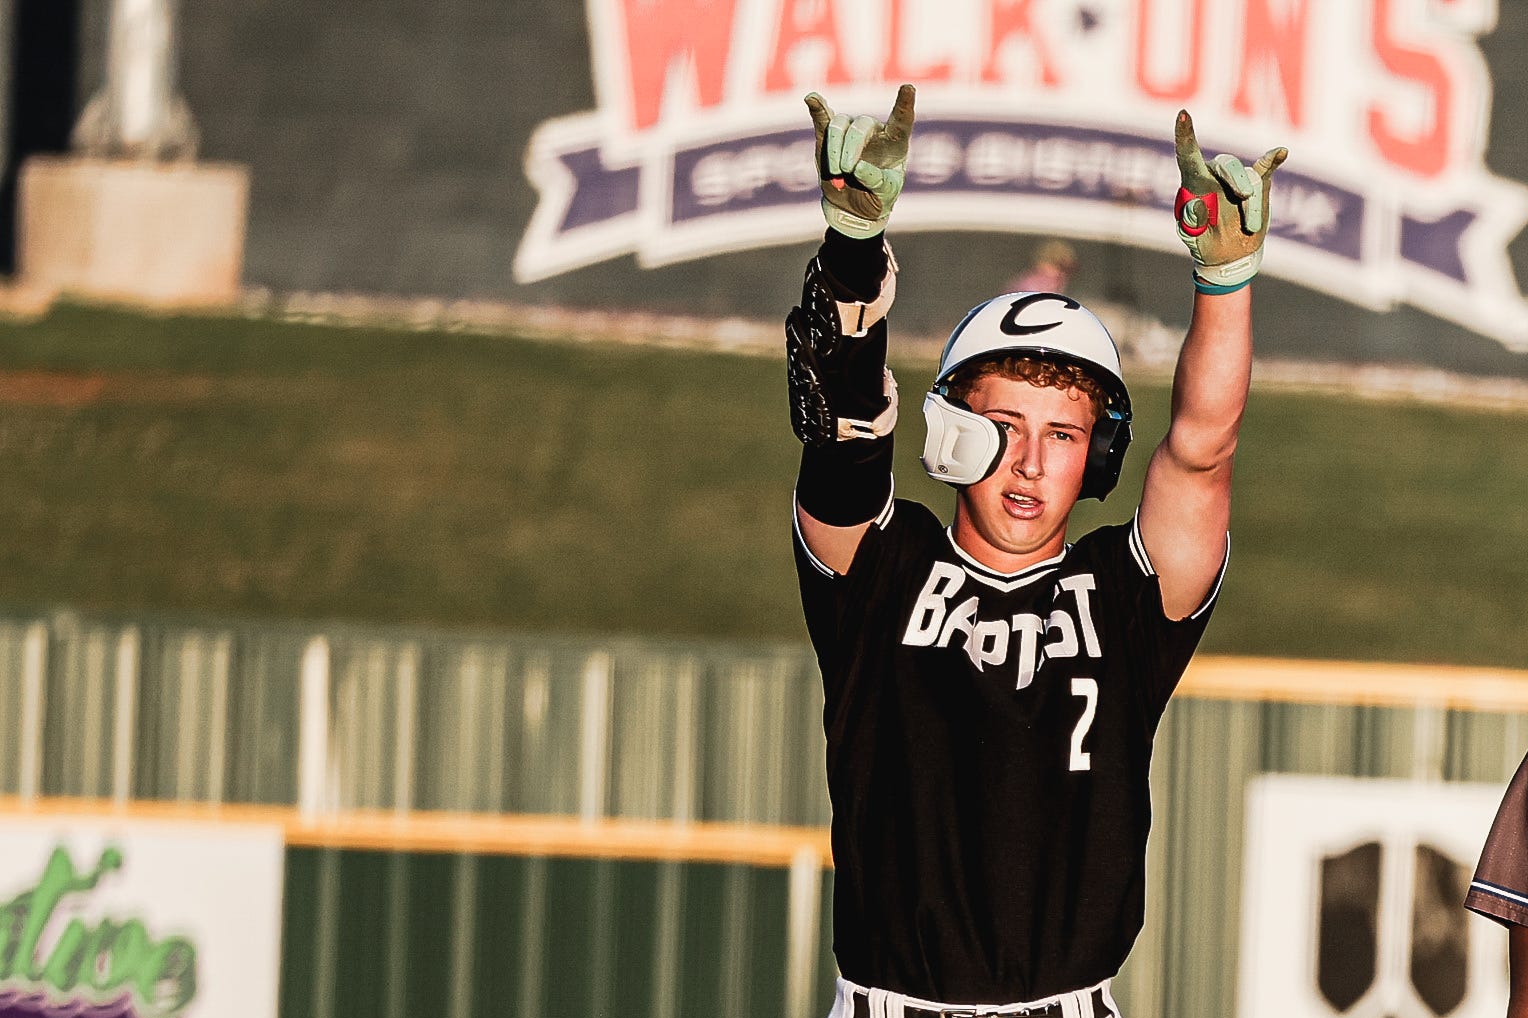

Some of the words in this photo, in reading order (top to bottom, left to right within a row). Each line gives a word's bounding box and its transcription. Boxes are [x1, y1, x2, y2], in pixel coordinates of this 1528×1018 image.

[1000, 293, 1080, 335] C
[902, 561, 1102, 690] BAPTST
[1069, 678, 1098, 771] 2
